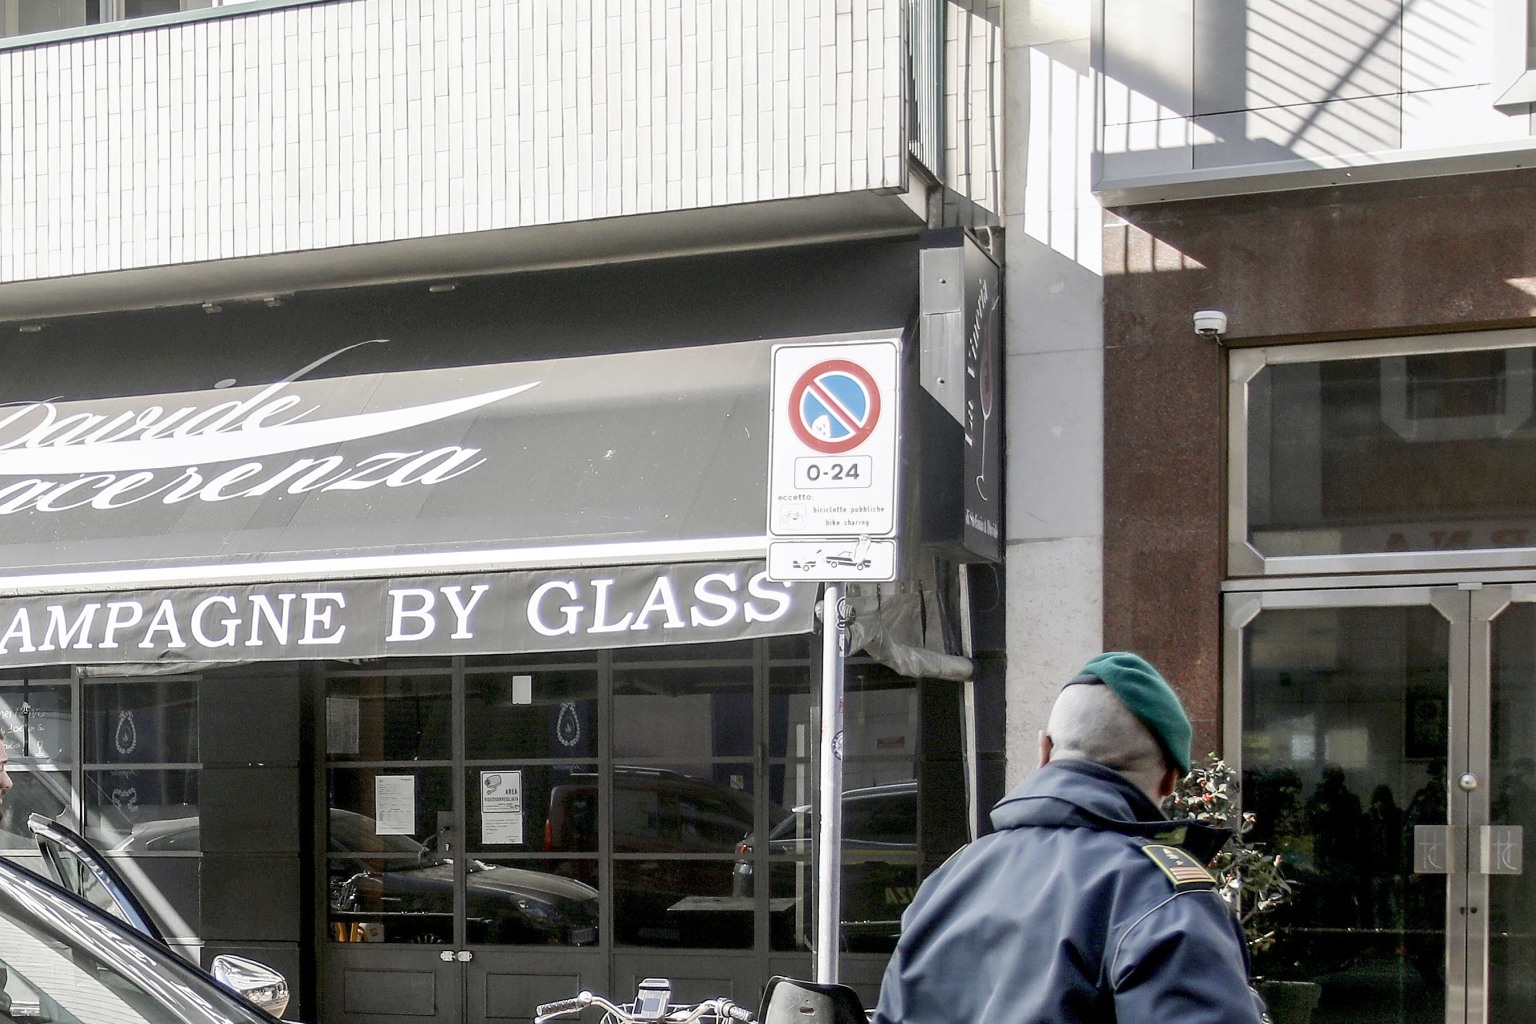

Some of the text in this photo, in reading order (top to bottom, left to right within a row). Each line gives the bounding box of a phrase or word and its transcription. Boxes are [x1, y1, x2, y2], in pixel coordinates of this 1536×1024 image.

[806, 463, 860, 481] 0-24
[385, 584, 489, 642] BY
[526, 573, 792, 636] GLASS
